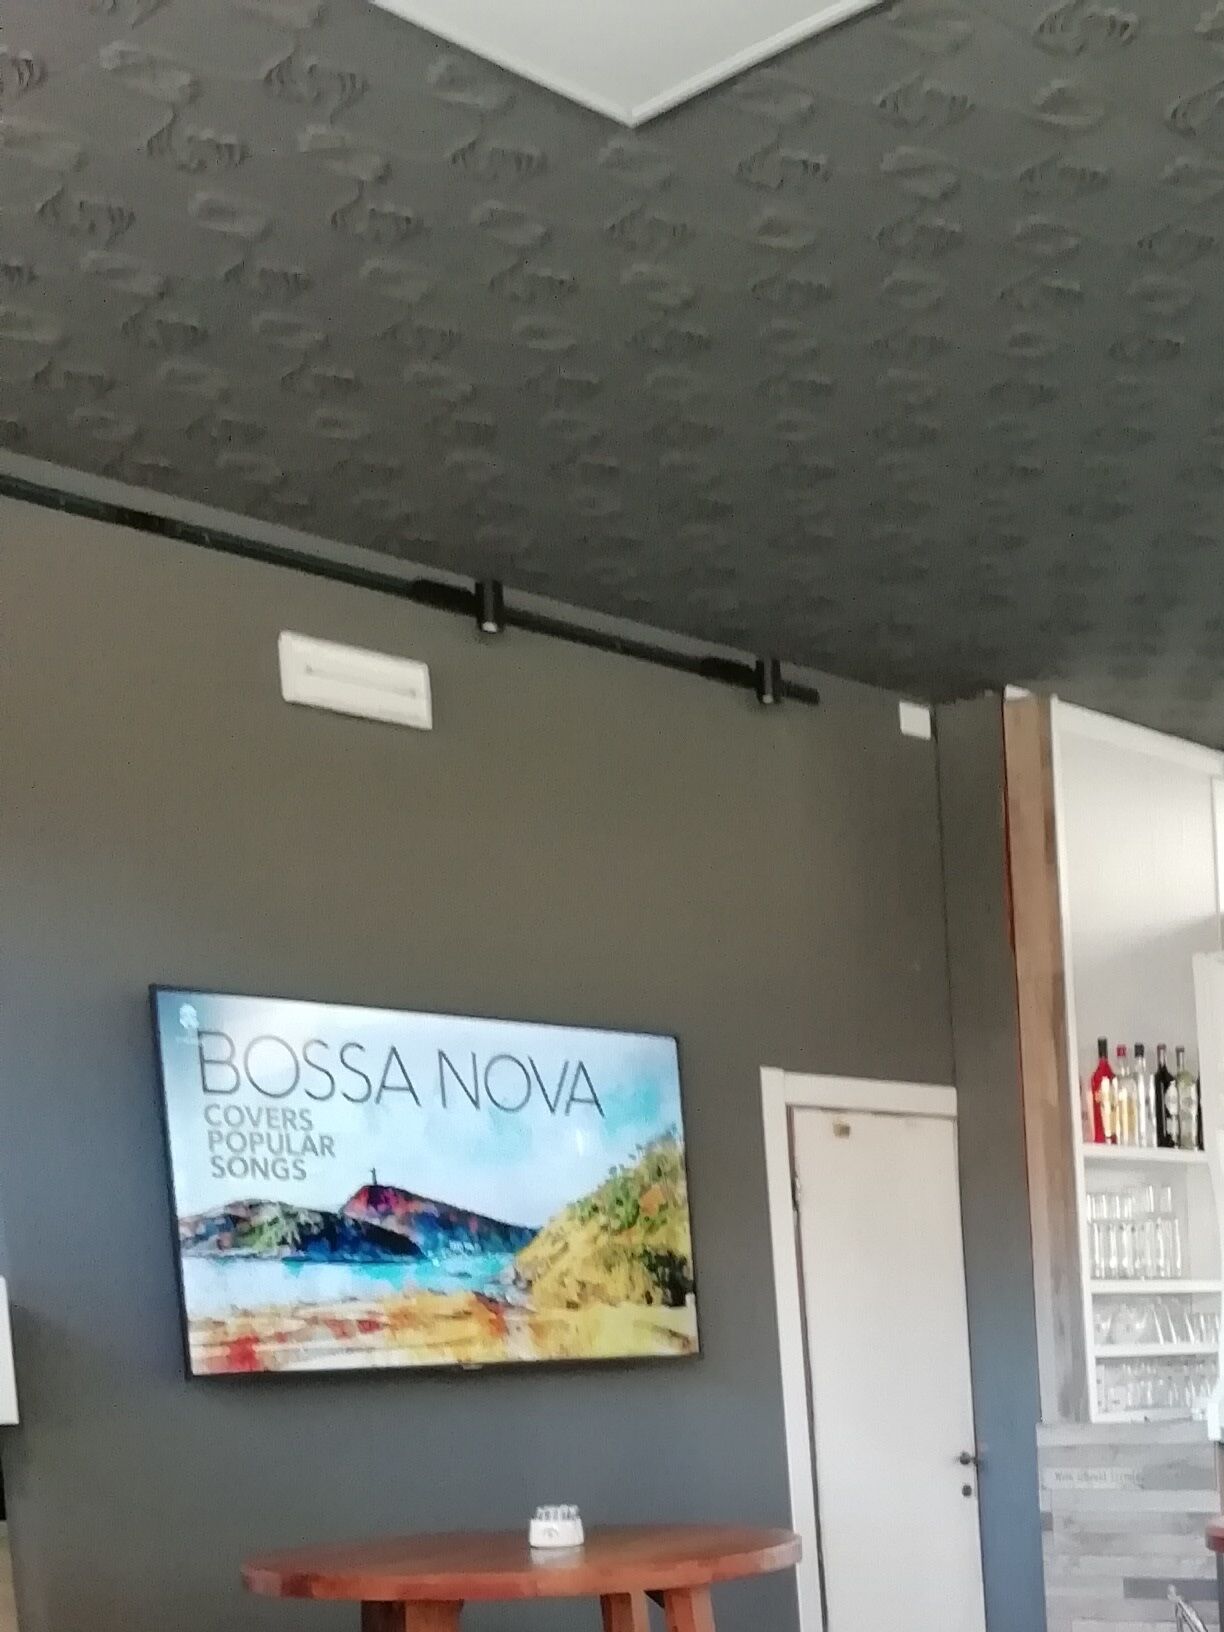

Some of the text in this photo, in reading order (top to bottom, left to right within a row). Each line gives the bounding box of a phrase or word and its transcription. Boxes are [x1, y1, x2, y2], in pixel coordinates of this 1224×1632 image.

[198, 1030, 606, 1119] BOSSA NOVA
[203, 1103, 315, 1132] COVERS
[207, 1129, 336, 1158] POPULAR
[210, 1155, 308, 1181] SONGS
